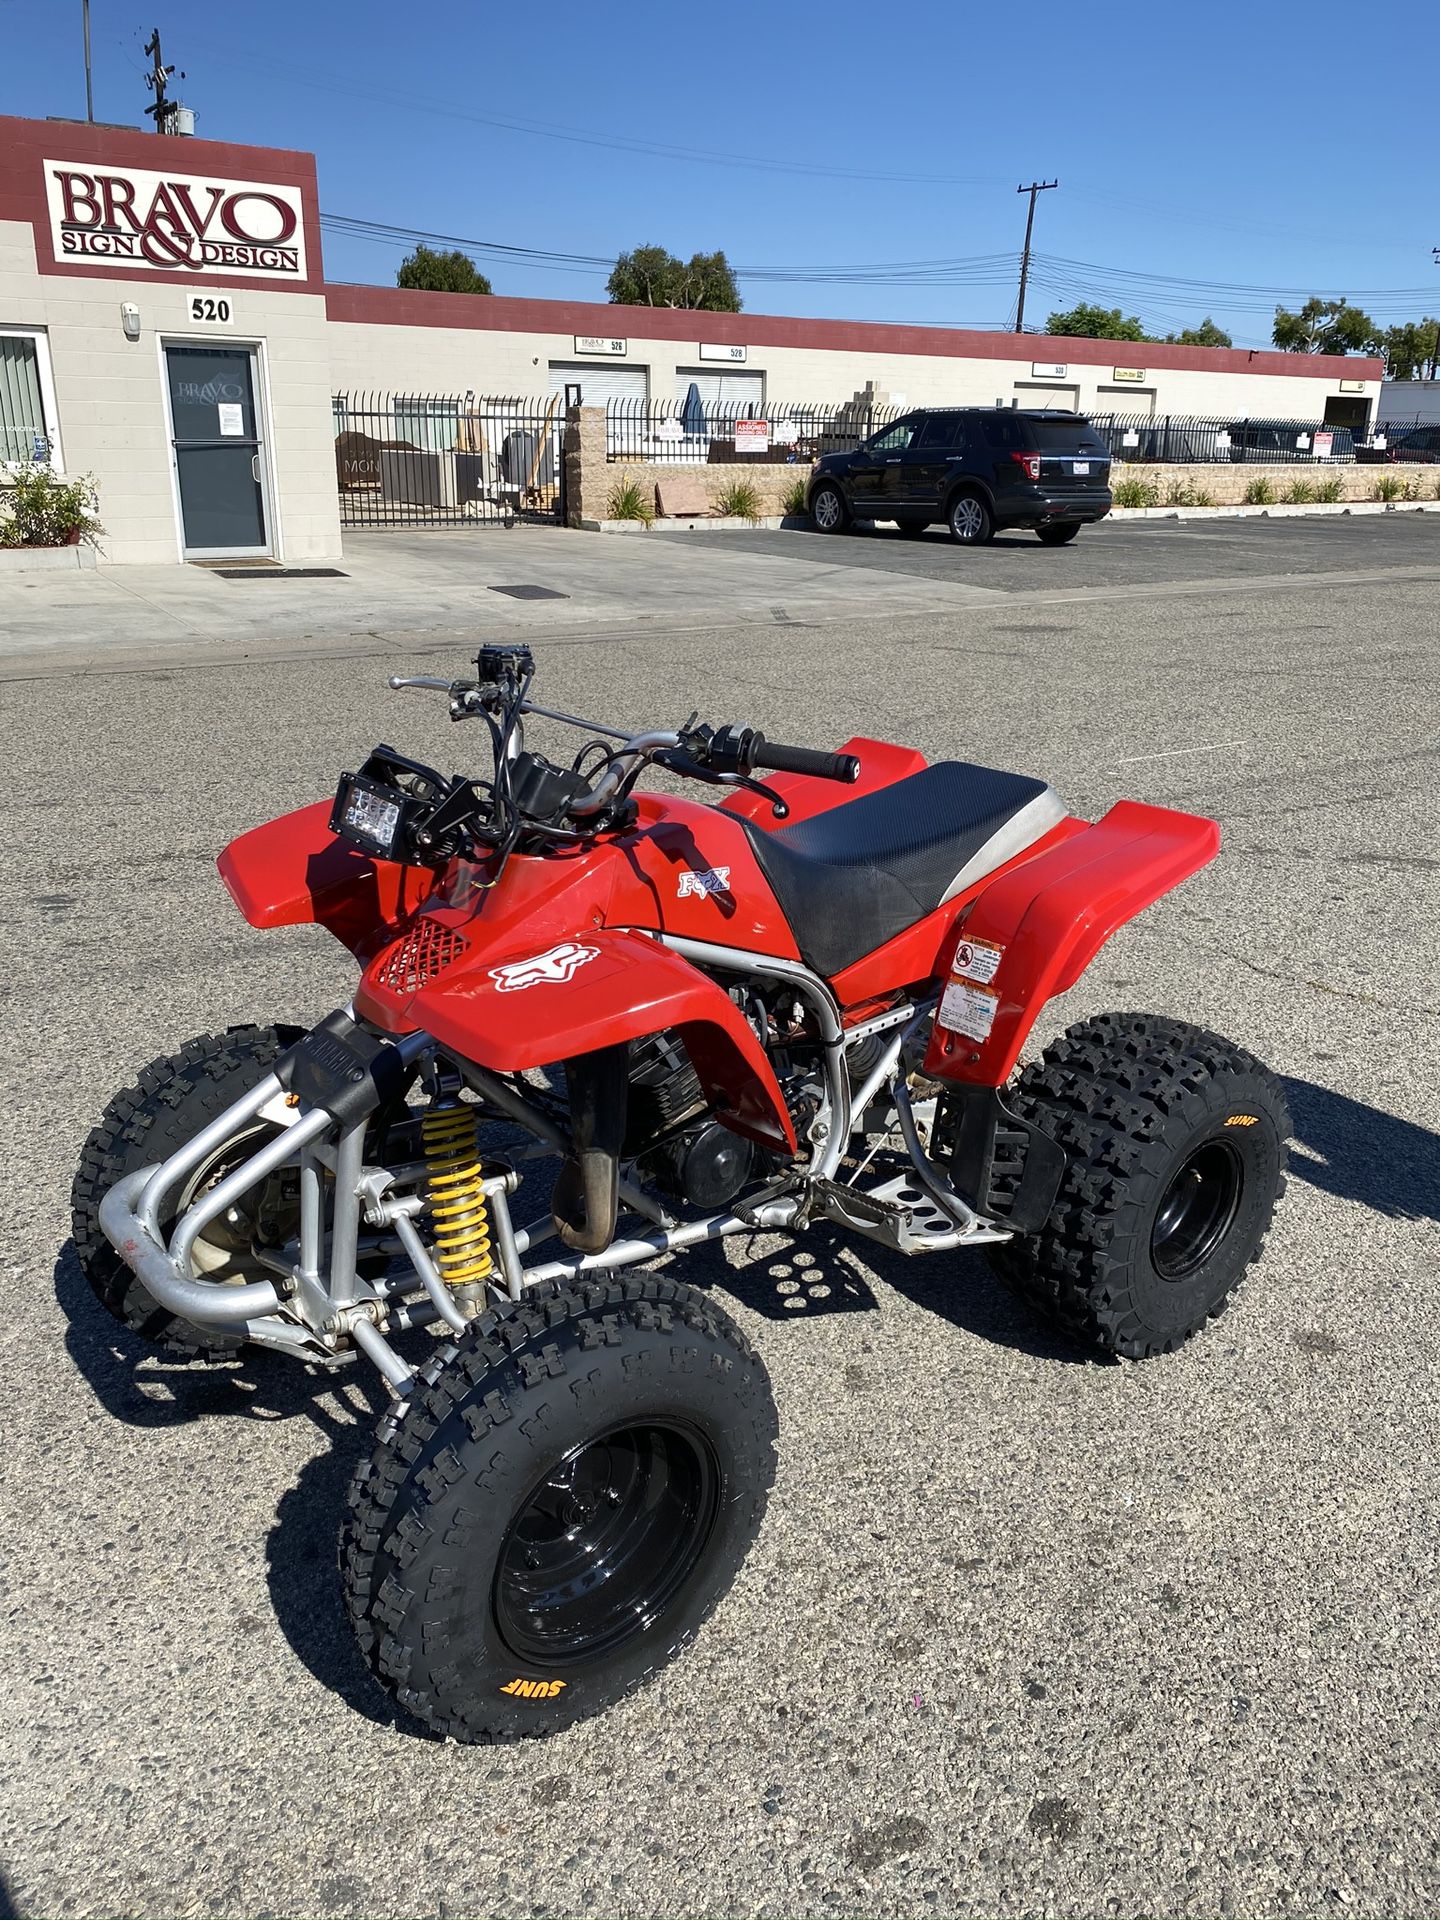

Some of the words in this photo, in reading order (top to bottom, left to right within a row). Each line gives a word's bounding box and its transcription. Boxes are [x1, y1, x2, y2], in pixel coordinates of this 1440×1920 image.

[53, 170, 297, 246] BRAVO
[62, 232, 134, 254] SIGN
[140, 213, 203, 270] &
[200, 243, 298, 270] DESIGN
[192, 298, 229, 322] 520
[611, 341, 623, 351] 526
[730, 348, 743, 358] 528
[178, 382, 243, 399] BRAVO
[678, 867, 730, 899] FOX
[1223, 1115, 1259, 1127] SUNF
[499, 1678, 568, 1698] SUNF
